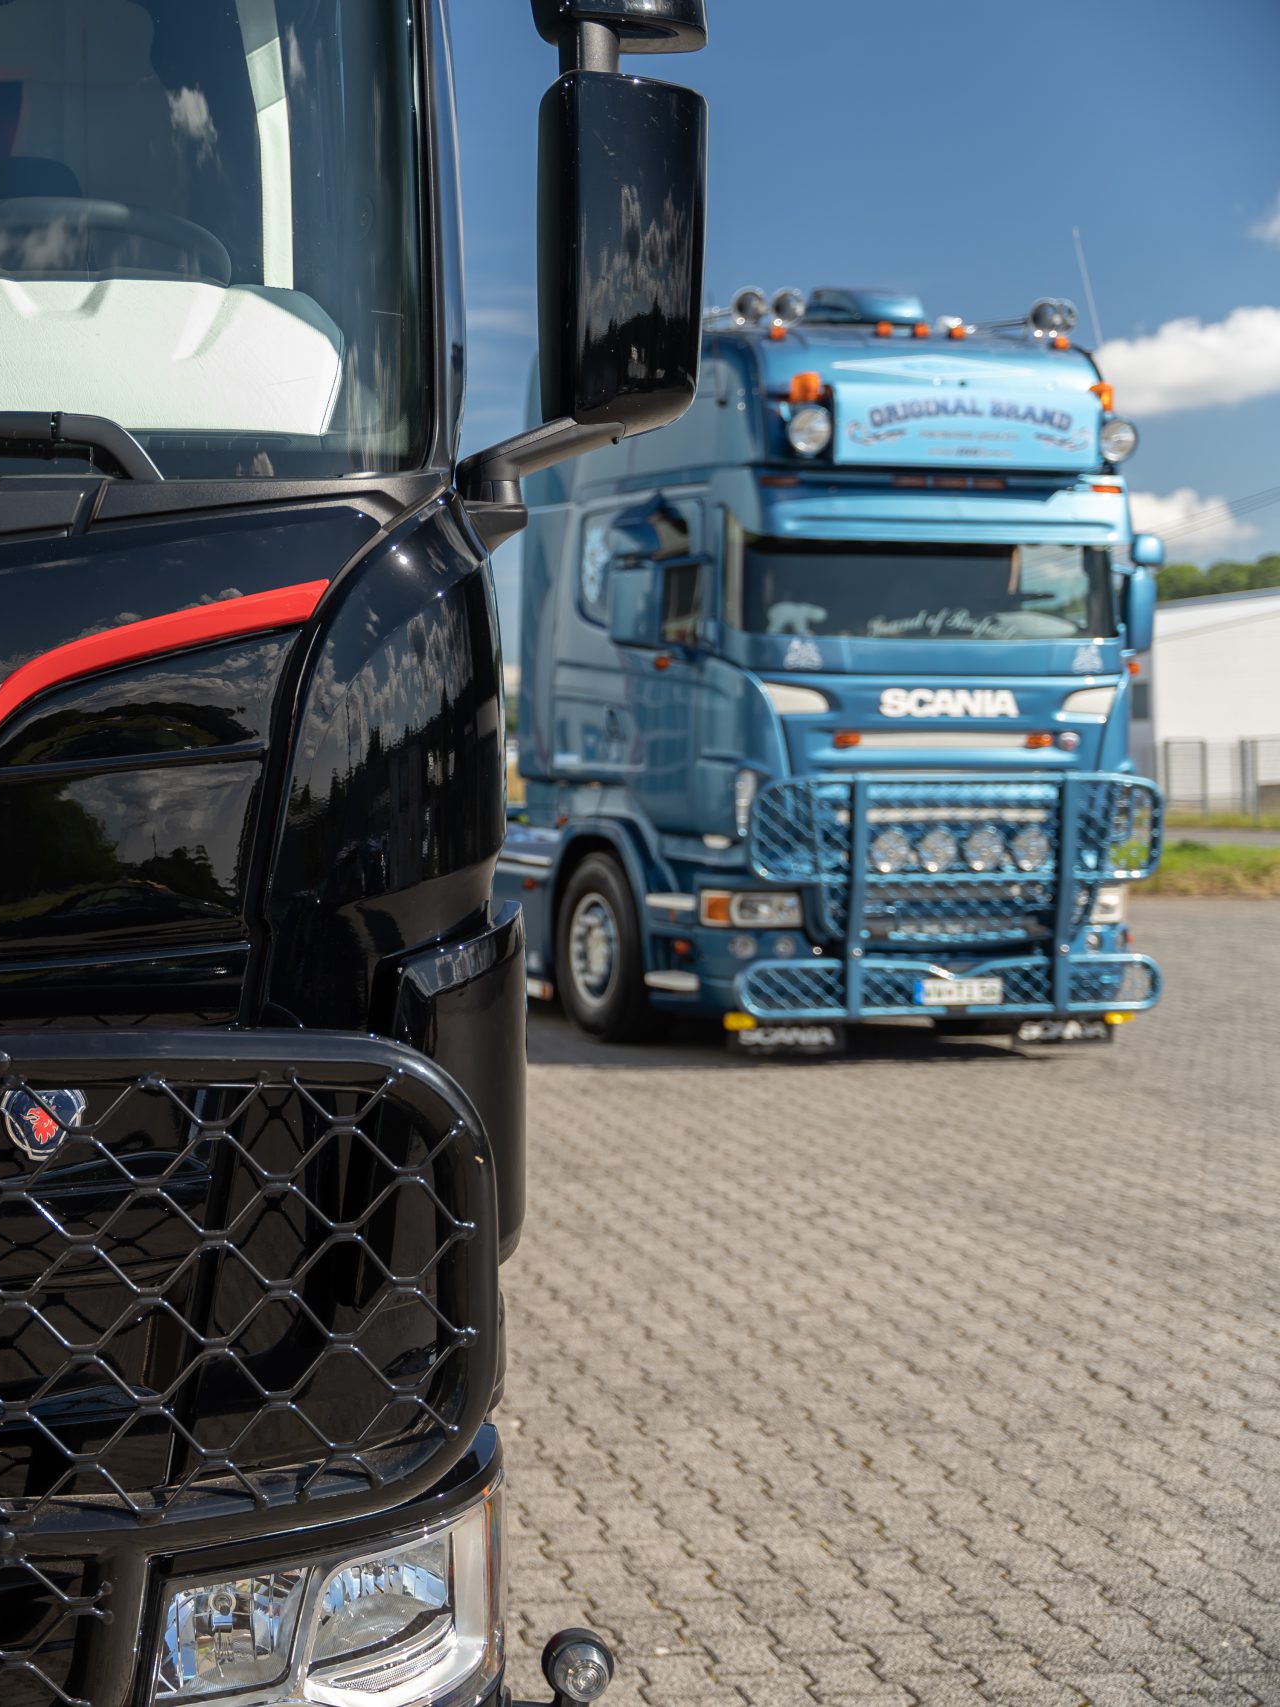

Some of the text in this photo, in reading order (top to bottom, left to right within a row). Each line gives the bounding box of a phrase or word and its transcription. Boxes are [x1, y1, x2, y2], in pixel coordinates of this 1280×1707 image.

[870, 397, 1072, 430] ORIGINAL BRAND
[879, 687, 1019, 718] SCANIA
[737, 1026, 836, 1046] SCANIA
